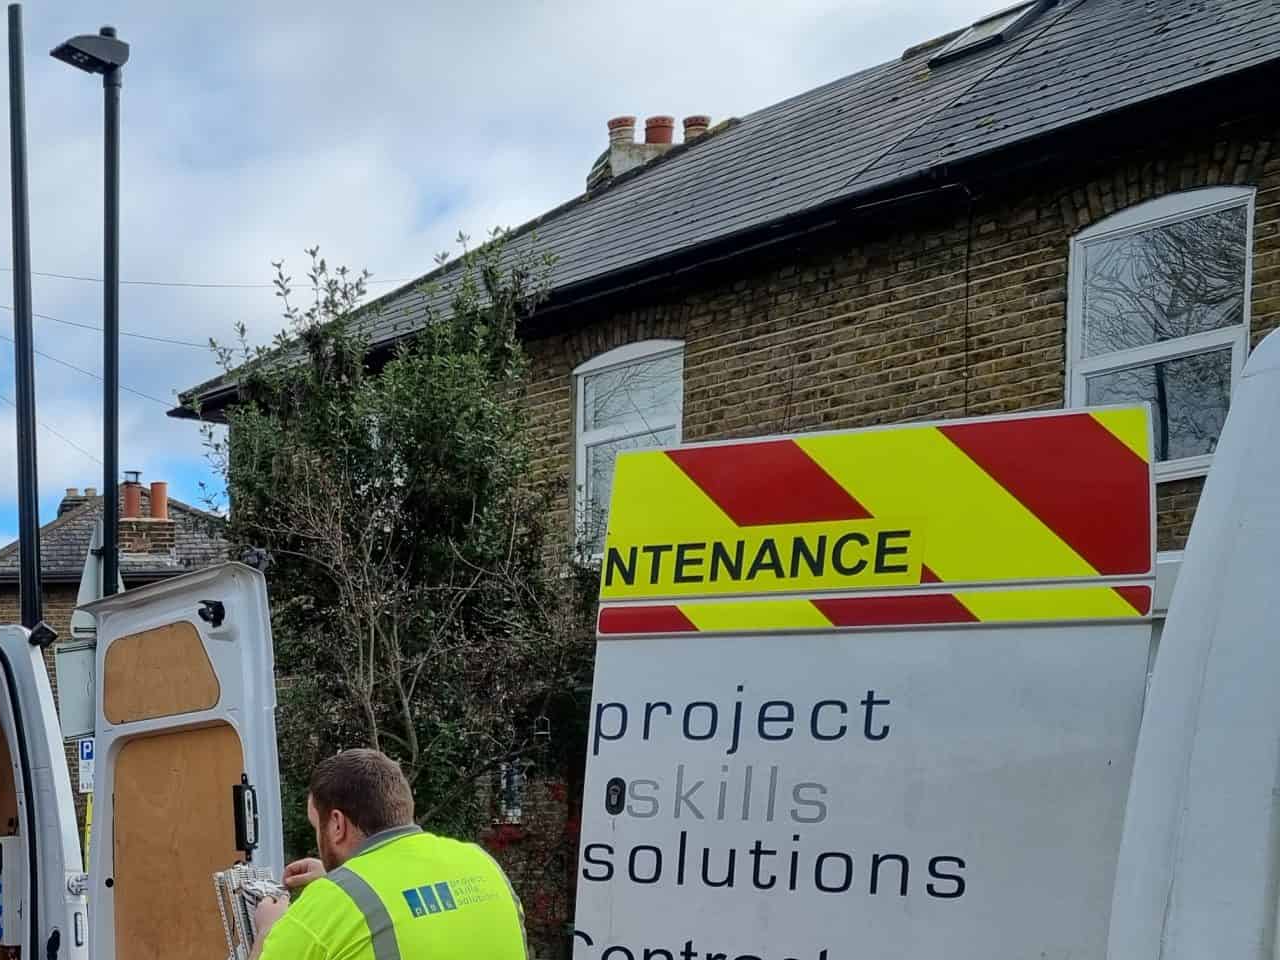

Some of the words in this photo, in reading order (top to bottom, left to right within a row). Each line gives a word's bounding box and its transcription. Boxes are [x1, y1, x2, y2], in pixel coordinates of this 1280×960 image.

[604, 530, 912, 587] NTENANCE
[592, 685, 891, 756] project
[626, 764, 829, 824] skills
[582, 830, 967, 899] solutions
